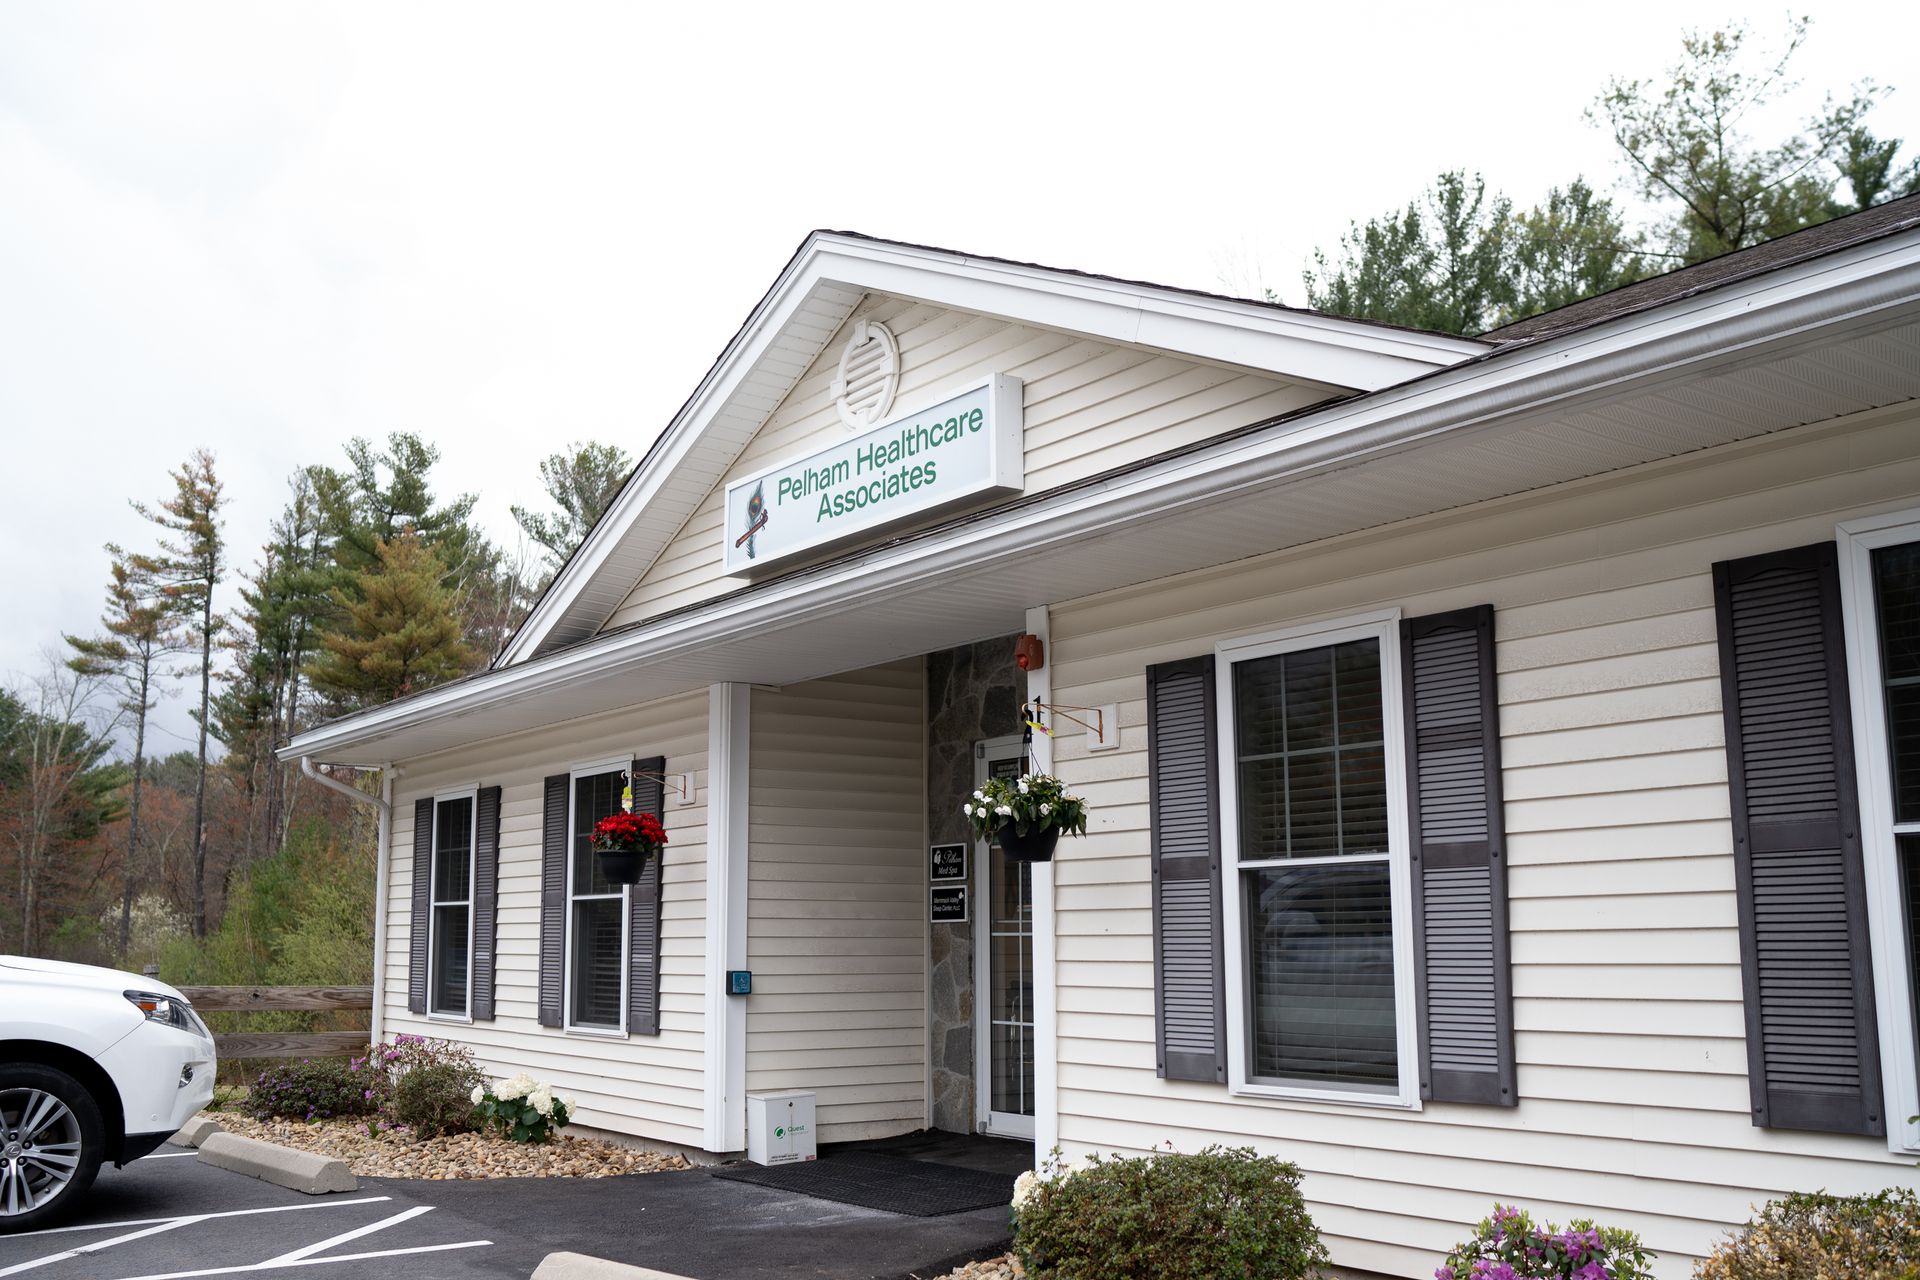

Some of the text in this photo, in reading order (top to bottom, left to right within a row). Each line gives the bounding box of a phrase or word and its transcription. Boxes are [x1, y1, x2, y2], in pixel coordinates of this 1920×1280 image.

[778, 408, 984, 506] Pelham Healthcare
[816, 460, 937, 523] Associates
[787, 1124, 804, 1132] Quest
